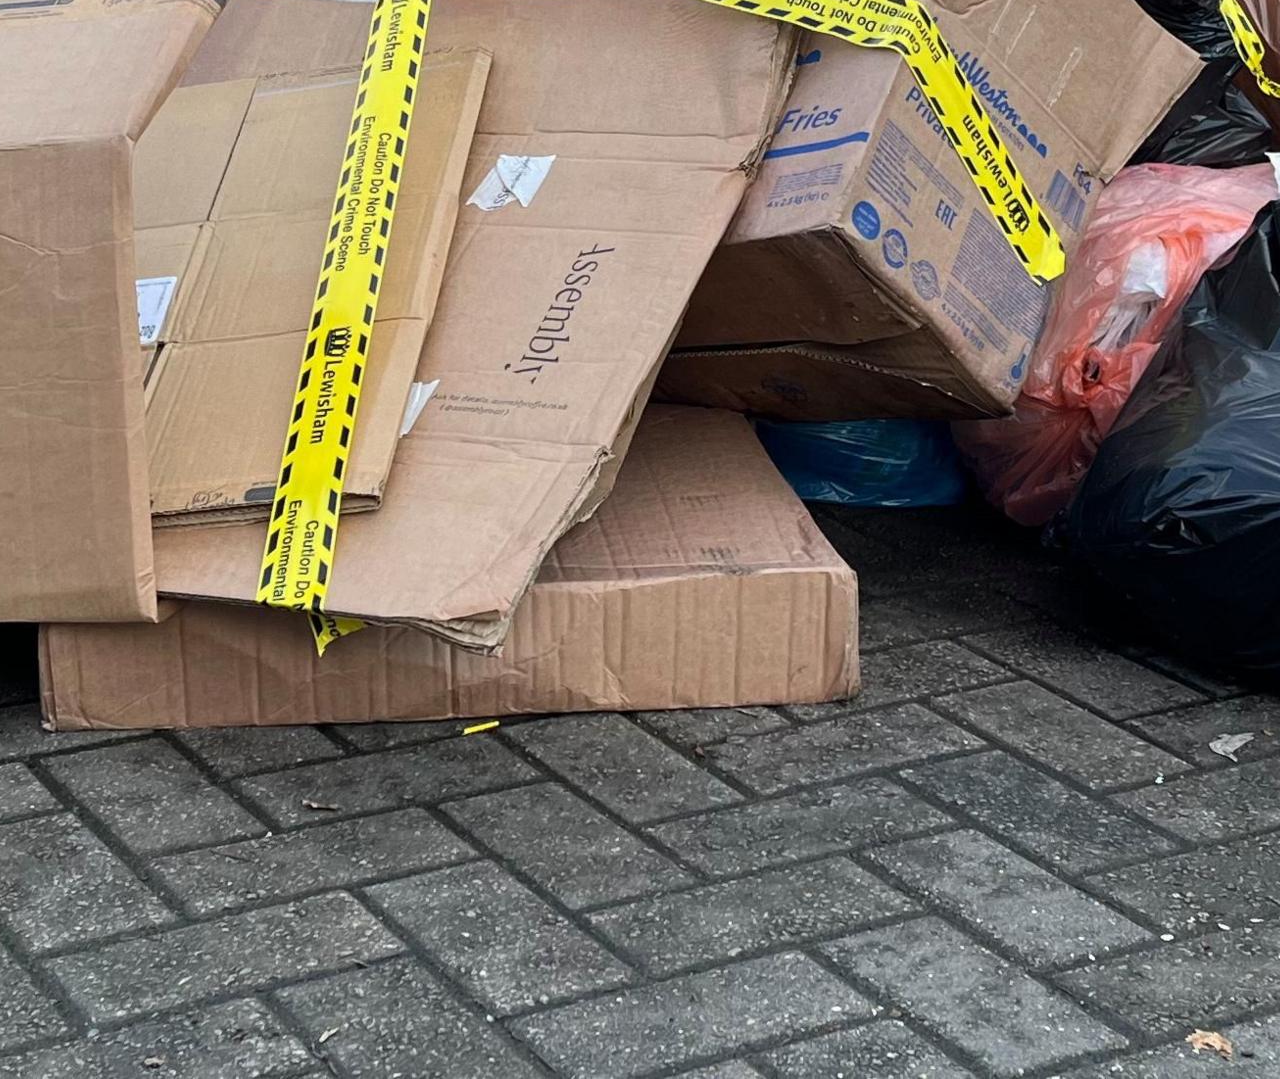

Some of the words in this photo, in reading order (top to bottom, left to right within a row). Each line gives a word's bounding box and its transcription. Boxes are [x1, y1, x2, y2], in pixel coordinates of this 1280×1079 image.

[829, 6, 854, 24] Not
[855, 15, 877, 33] Do
[380, 4, 406, 71] Lewisham
[878, 22, 920, 53] Caution
[775, 105, 842, 134] Fries
[349, 115, 375, 195] Environmental
[371, 131, 392, 176] Caution
[960, 114, 1013, 200] Lewisham
[368, 177, 383, 194] Do
[342, 197, 360, 233] Crime
[364, 197, 380, 218] Not
[334, 234, 353, 273] Scene
[357, 218, 376, 256] Touch
[504, 243, 614, 384] Assembly
[310, 360, 342, 443] Lewisham
[271, 500, 302, 601] Environmental
[297, 518, 319, 576] Caution
[293, 579, 310, 600] Do
